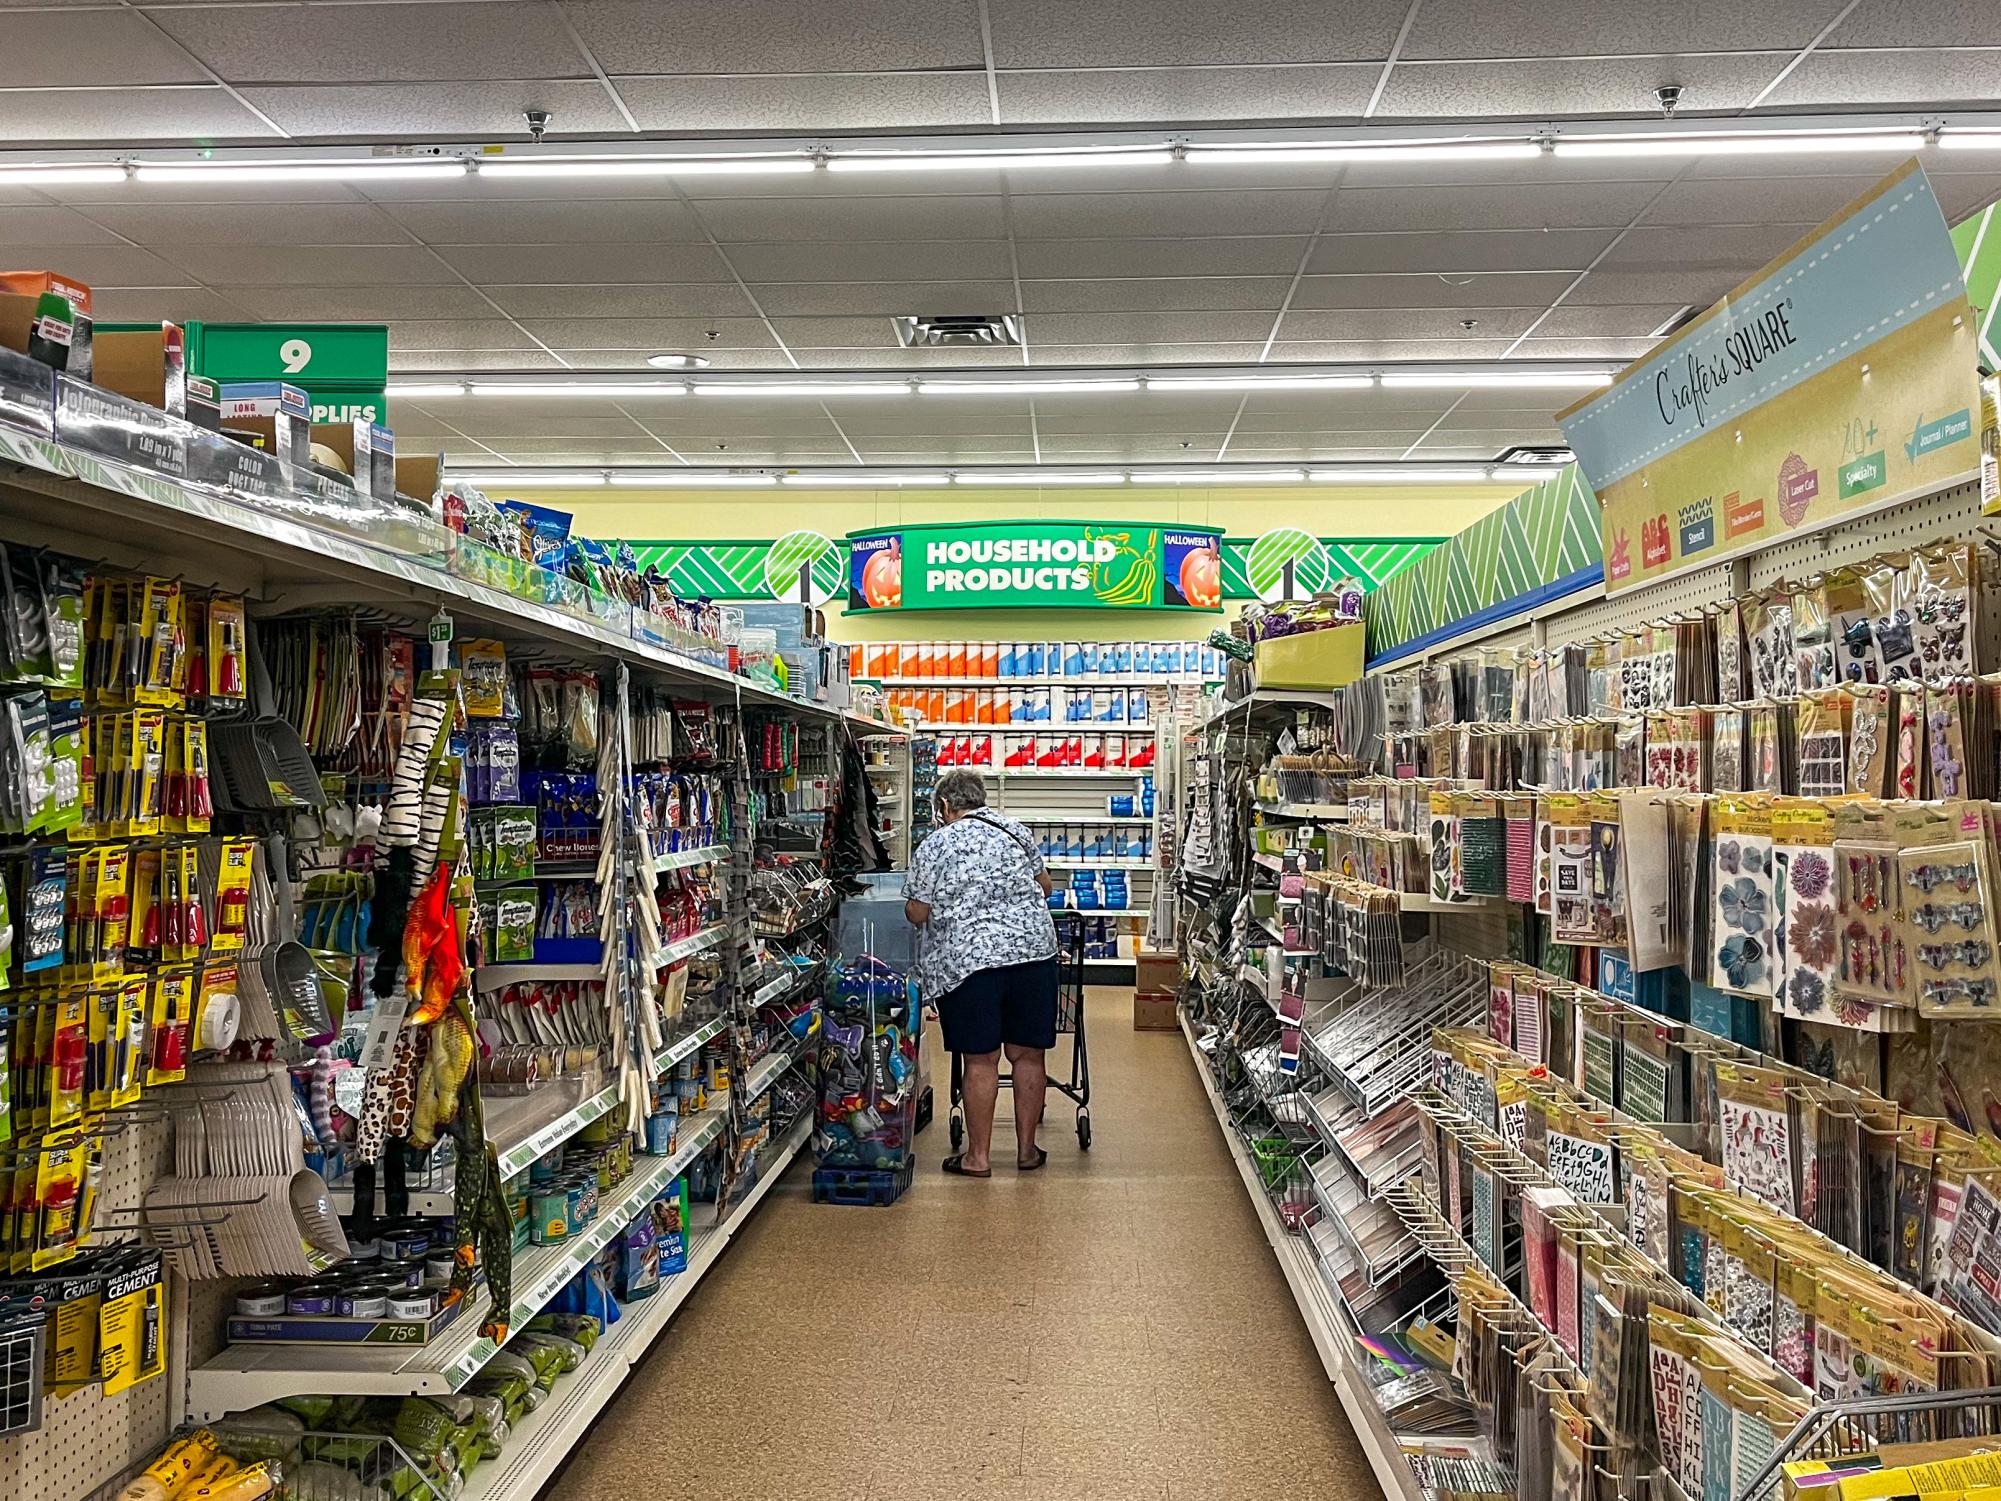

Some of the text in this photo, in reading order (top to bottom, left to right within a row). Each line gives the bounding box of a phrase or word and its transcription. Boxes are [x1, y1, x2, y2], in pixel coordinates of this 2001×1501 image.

[279, 339, 313, 373] 9
[1656, 354, 1729, 428] Crafter's
[234, 404, 256, 413] LONG
[238, 456, 263, 476] COLOR
[1846, 463, 1877, 486] Specialty
[228, 471, 250, 489] DUCT
[851, 538, 888, 552] HALLOWEEN
[1164, 534, 1208, 547] HALLOWEEN
[1688, 528, 1705, 545] Stencil
[927, 539, 1116, 564] HOUSEHOLD
[927, 567, 1090, 592] PRODUCTS
[546, 844, 571, 852] Chew
[164, 980, 180, 989] SUPER
[50, 1149, 69, 1159] SUPER
[1973, 1200, 1991, 1221] HOME
[670, 1245, 684, 1255] Size
[107, 1261, 159, 1288] MULTI-PURPOSE
[108, 1271, 158, 1299] CEMENT
[388, 1326, 417, 1341] 75¢
